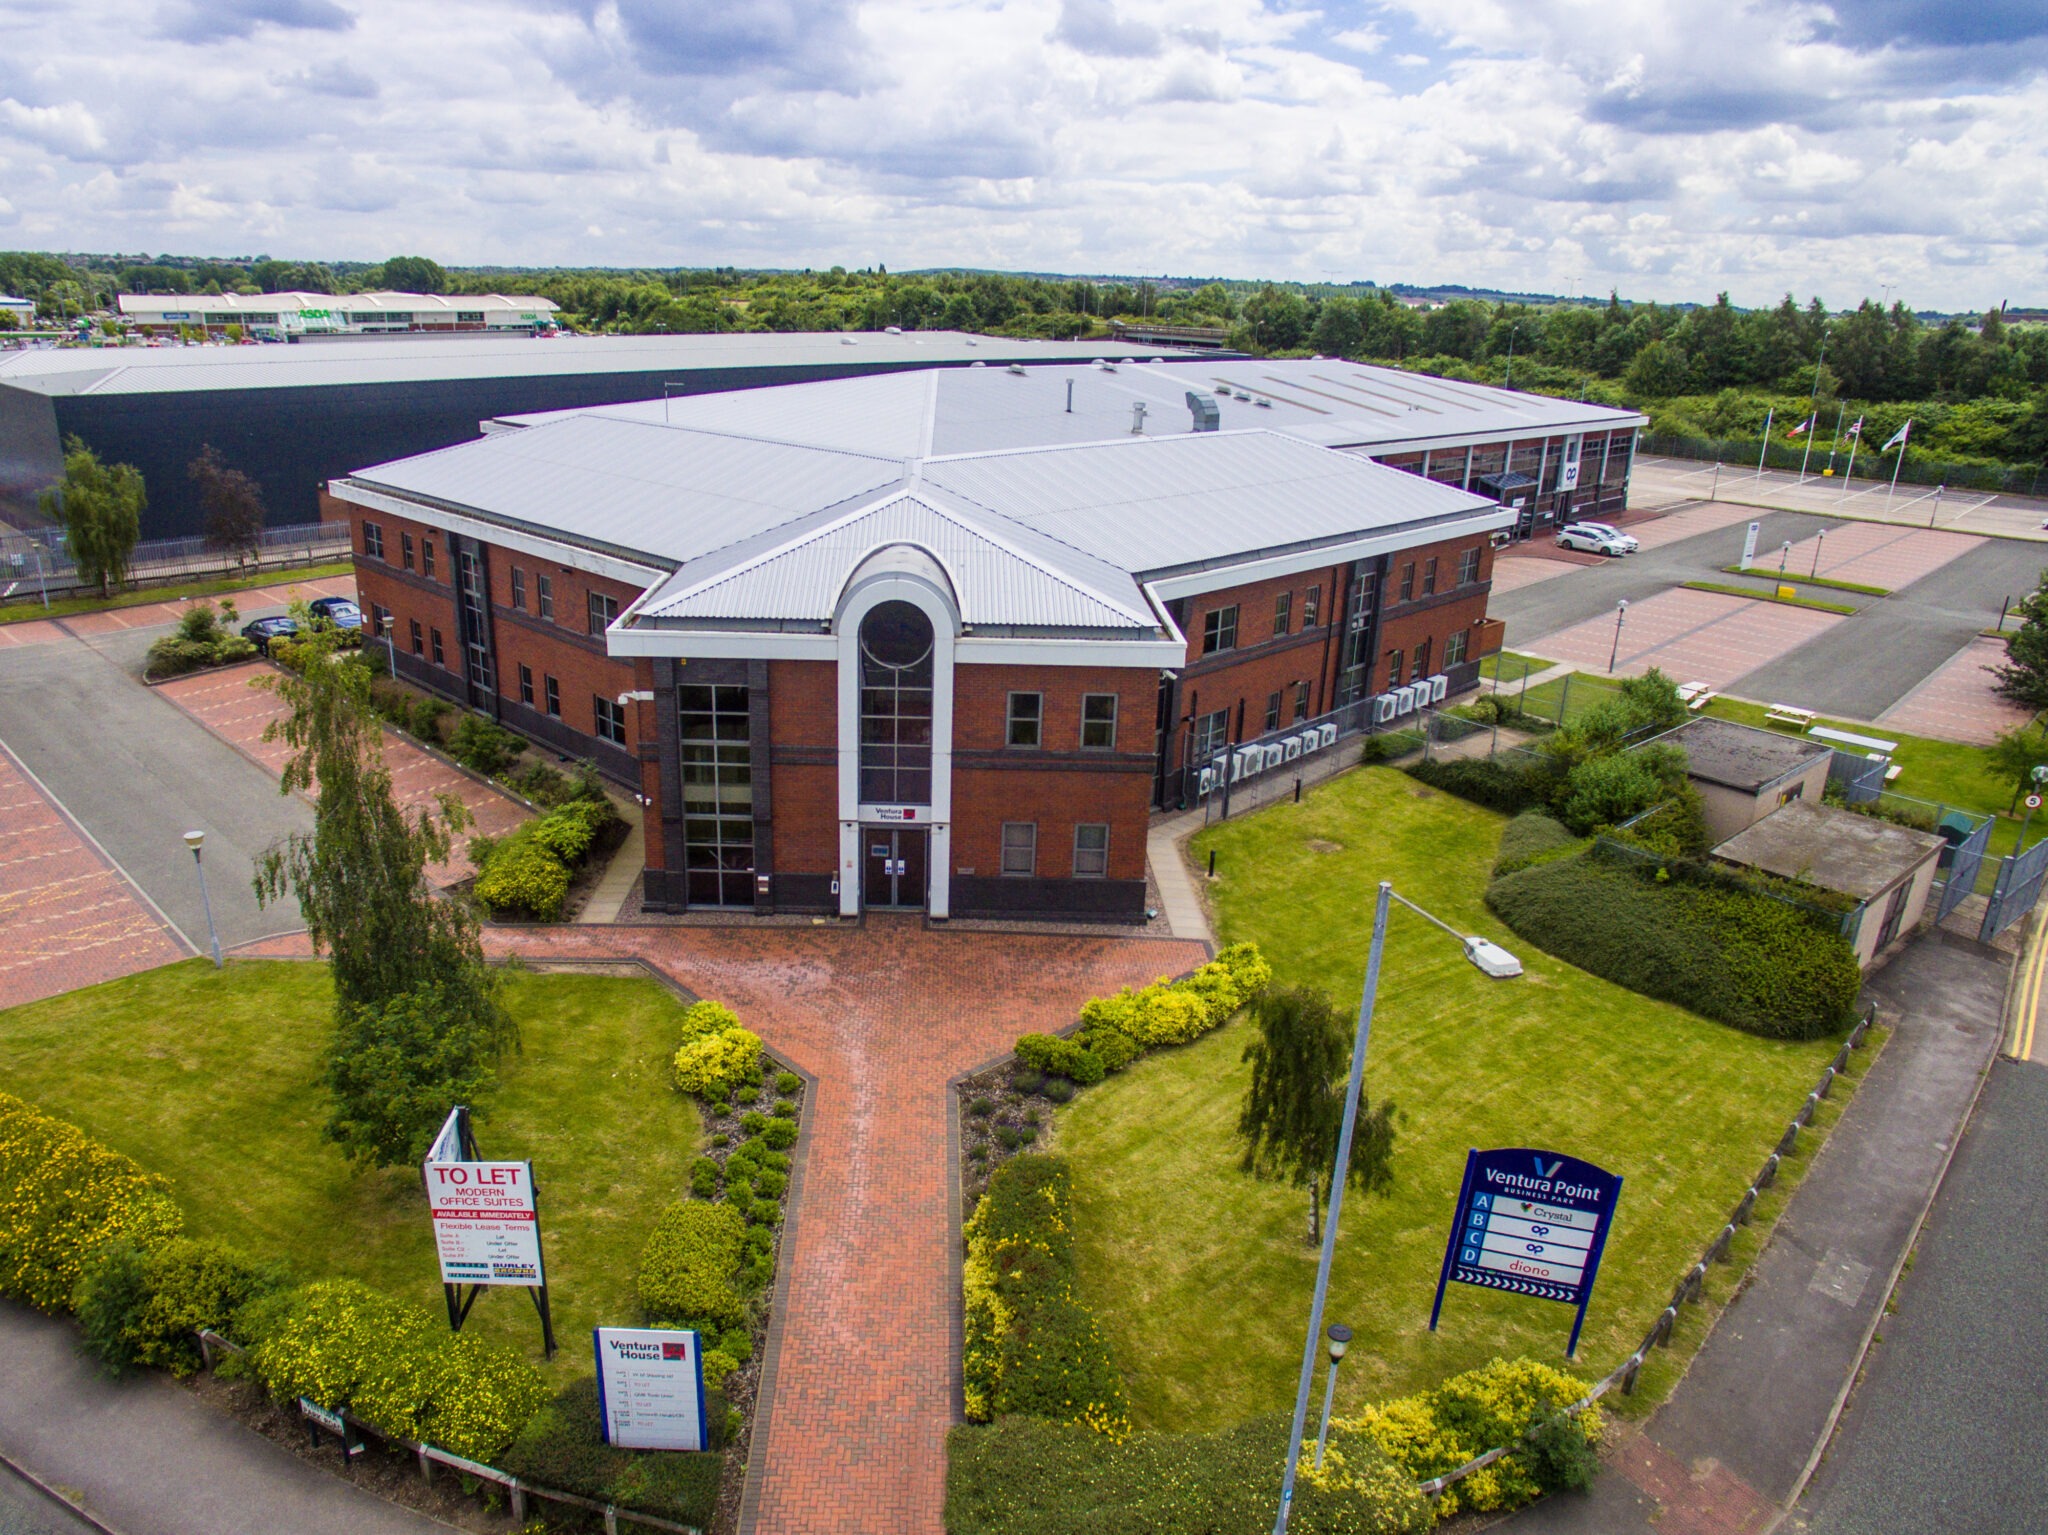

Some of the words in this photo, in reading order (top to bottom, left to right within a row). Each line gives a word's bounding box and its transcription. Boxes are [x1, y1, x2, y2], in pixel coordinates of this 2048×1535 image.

[299, 309, 330, 318] ASDA
[433, 1167, 468, 1185] TO
[476, 1168, 521, 1185] LET
[1486, 1168, 1550, 1192] Ventura
[1554, 1181, 1601, 1201] Point
[455, 1188, 505, 1197] MODERN
[1504, 1187, 1548, 1199] BUSINESS
[1551, 1195, 1575, 1205] PARK
[440, 1196, 480, 1206] OFFICE
[484, 1197, 524, 1206] SUITES
[1476, 1196, 1489, 1208] A
[480, 1211, 531, 1219] IMMEDIATELY
[1473, 1213, 1484, 1226] B
[1533, 1207, 1573, 1222] Crystal
[475, 1223, 501, 1231] Lease
[504, 1224, 530, 1232] Terms
[1470, 1232, 1480, 1244] C
[1464, 1249, 1476, 1262] D
[1509, 1260, 1550, 1277] diono
[610, 1340, 660, 1351] Ventura
[620, 1350, 660, 1360] House
